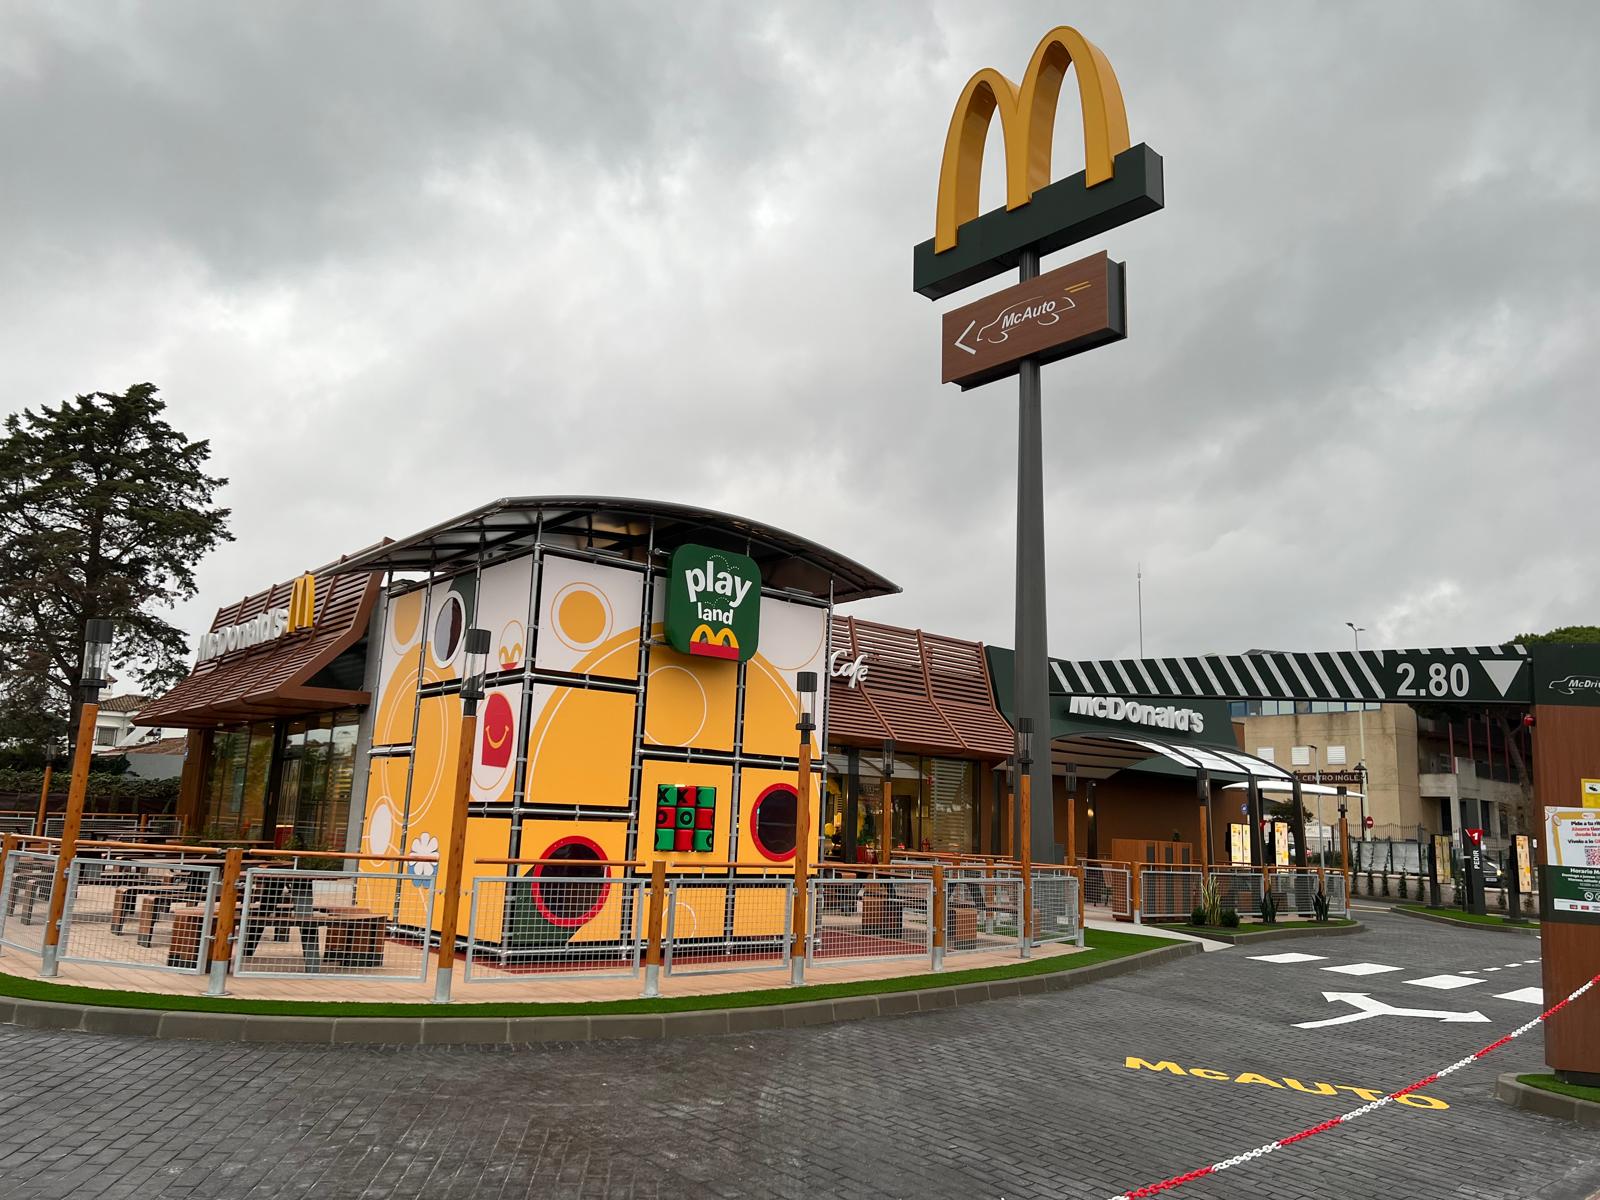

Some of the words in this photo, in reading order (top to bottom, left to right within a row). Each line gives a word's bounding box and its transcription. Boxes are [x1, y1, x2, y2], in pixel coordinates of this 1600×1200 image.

[1001, 299, 1056, 330] McAuto
[684, 554, 753, 608] play
[696, 604, 735, 626] land
[197, 607, 289, 663] McDonald's
[1396, 662, 1470, 698] 2.80
[1068, 696, 1204, 734] McDonald's
[1472, 832, 1479, 841] 1
[1472, 849, 1481, 870] PEDIR
[1123, 1055, 1450, 1111] McAUTO
